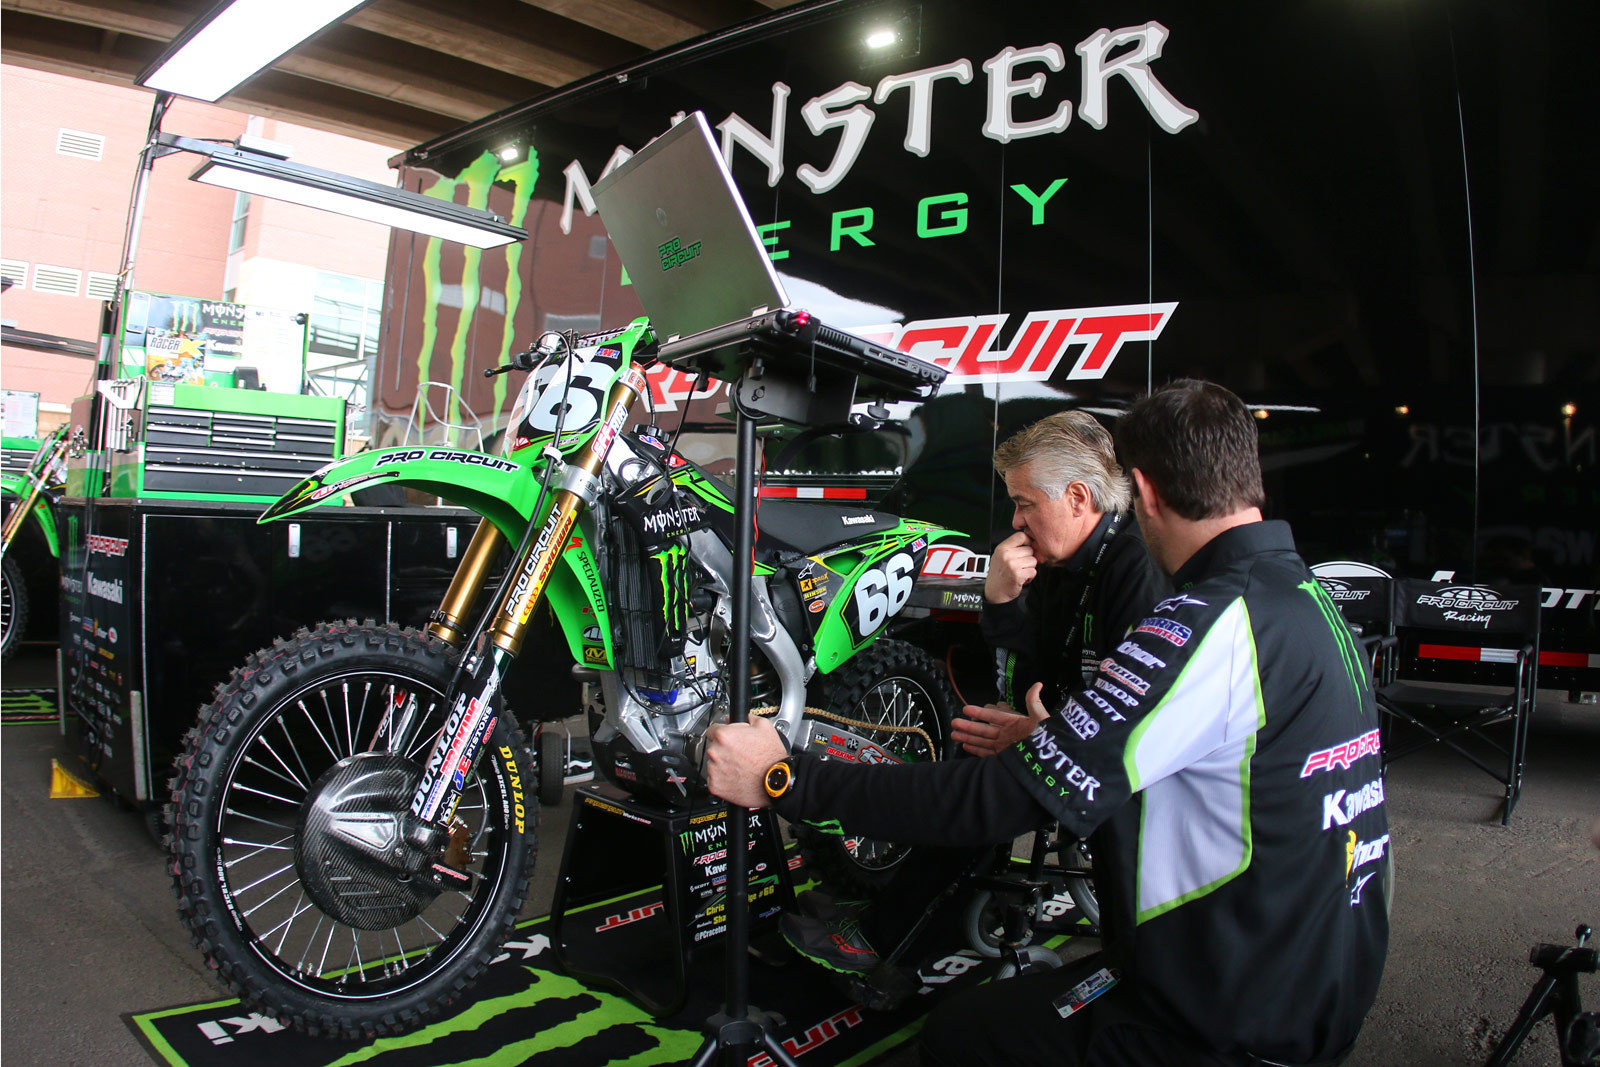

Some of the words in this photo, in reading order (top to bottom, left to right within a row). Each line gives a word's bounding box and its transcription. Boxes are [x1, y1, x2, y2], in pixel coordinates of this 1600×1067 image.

[560, 21, 1200, 234] MNSTER
[658, 236, 681, 258] PRO
[661, 241, 702, 271] CIRCUIT
[150, 338, 181, 351] RACER
[374, 450, 425, 469] PRO
[428, 450, 520, 474] CIRCUIT
[643, 506, 701, 533] MONSTER
[841, 515, 875, 525] Kawasaki
[504, 573, 530, 616] PRO
[528, 503, 564, 577] CIRCUIT
[576, 551, 605, 613] SPECIALIZED
[854, 552, 915, 637] 66
[953, 593, 983, 604] MONS
[1416, 594, 1455, 609] PRO
[1454, 598, 1519, 611] CIRCUIT
[1443, 610, 1492, 629] Racing
[1083, 689, 1127, 722] COTT
[440, 696, 483, 777] BRAKING
[453, 755, 472, 790] JE
[469, 706, 493, 759] PISTONS
[830, 734, 846, 746] RK
[410, 691, 467, 817] DUNLOP
[1017, 741, 1070, 797] NERGY
[499, 745, 526, 835] DUNLOP
[706, 904, 725, 916] Chris
